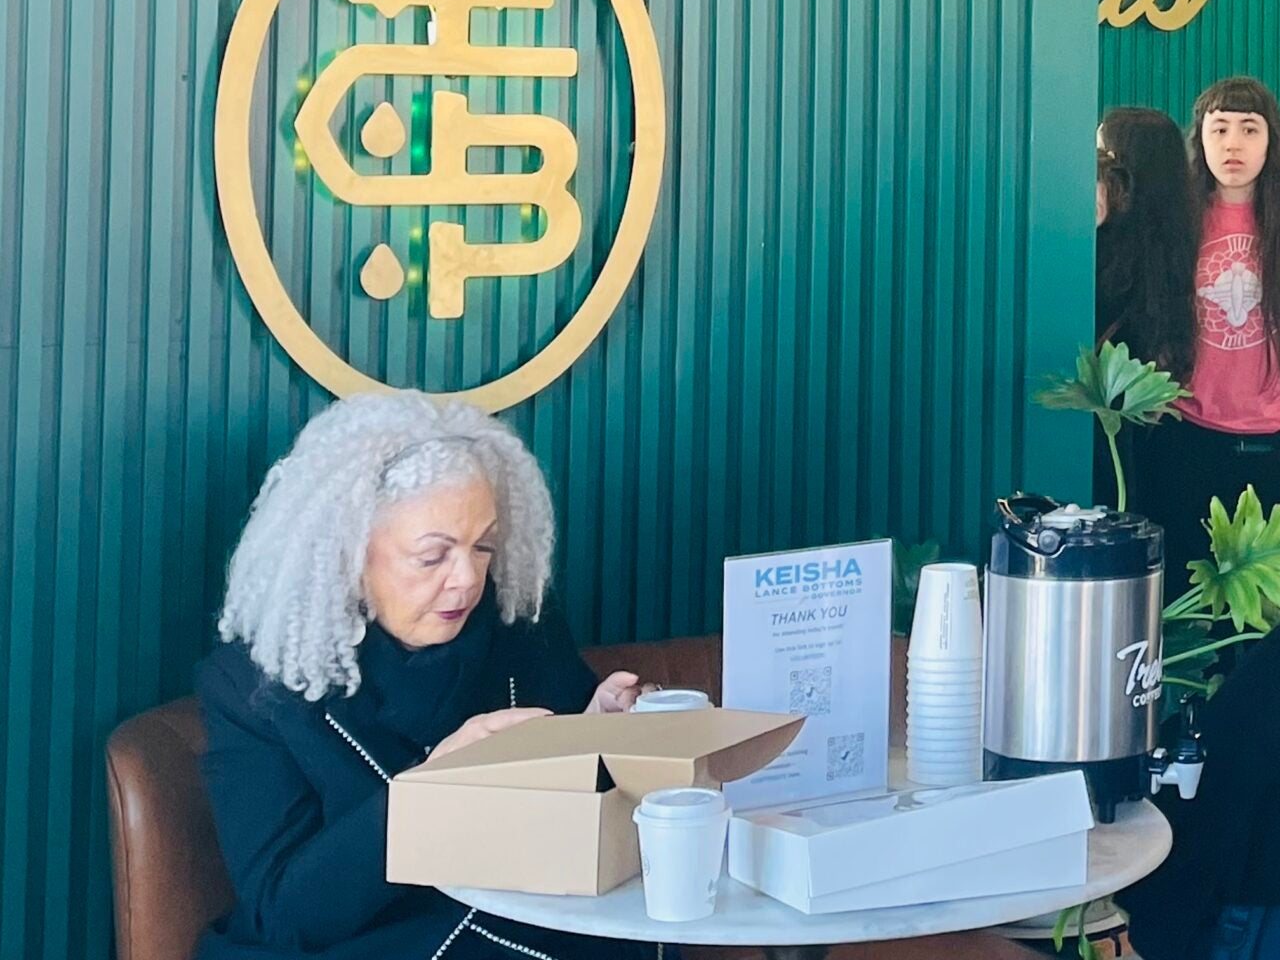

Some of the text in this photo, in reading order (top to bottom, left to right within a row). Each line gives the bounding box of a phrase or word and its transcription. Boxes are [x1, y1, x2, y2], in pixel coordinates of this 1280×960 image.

[755, 558, 862, 588] KEISHA
[755, 578, 862, 598] LANCE BOTTOMS
[771, 605, 848, 626] THANK YOU
